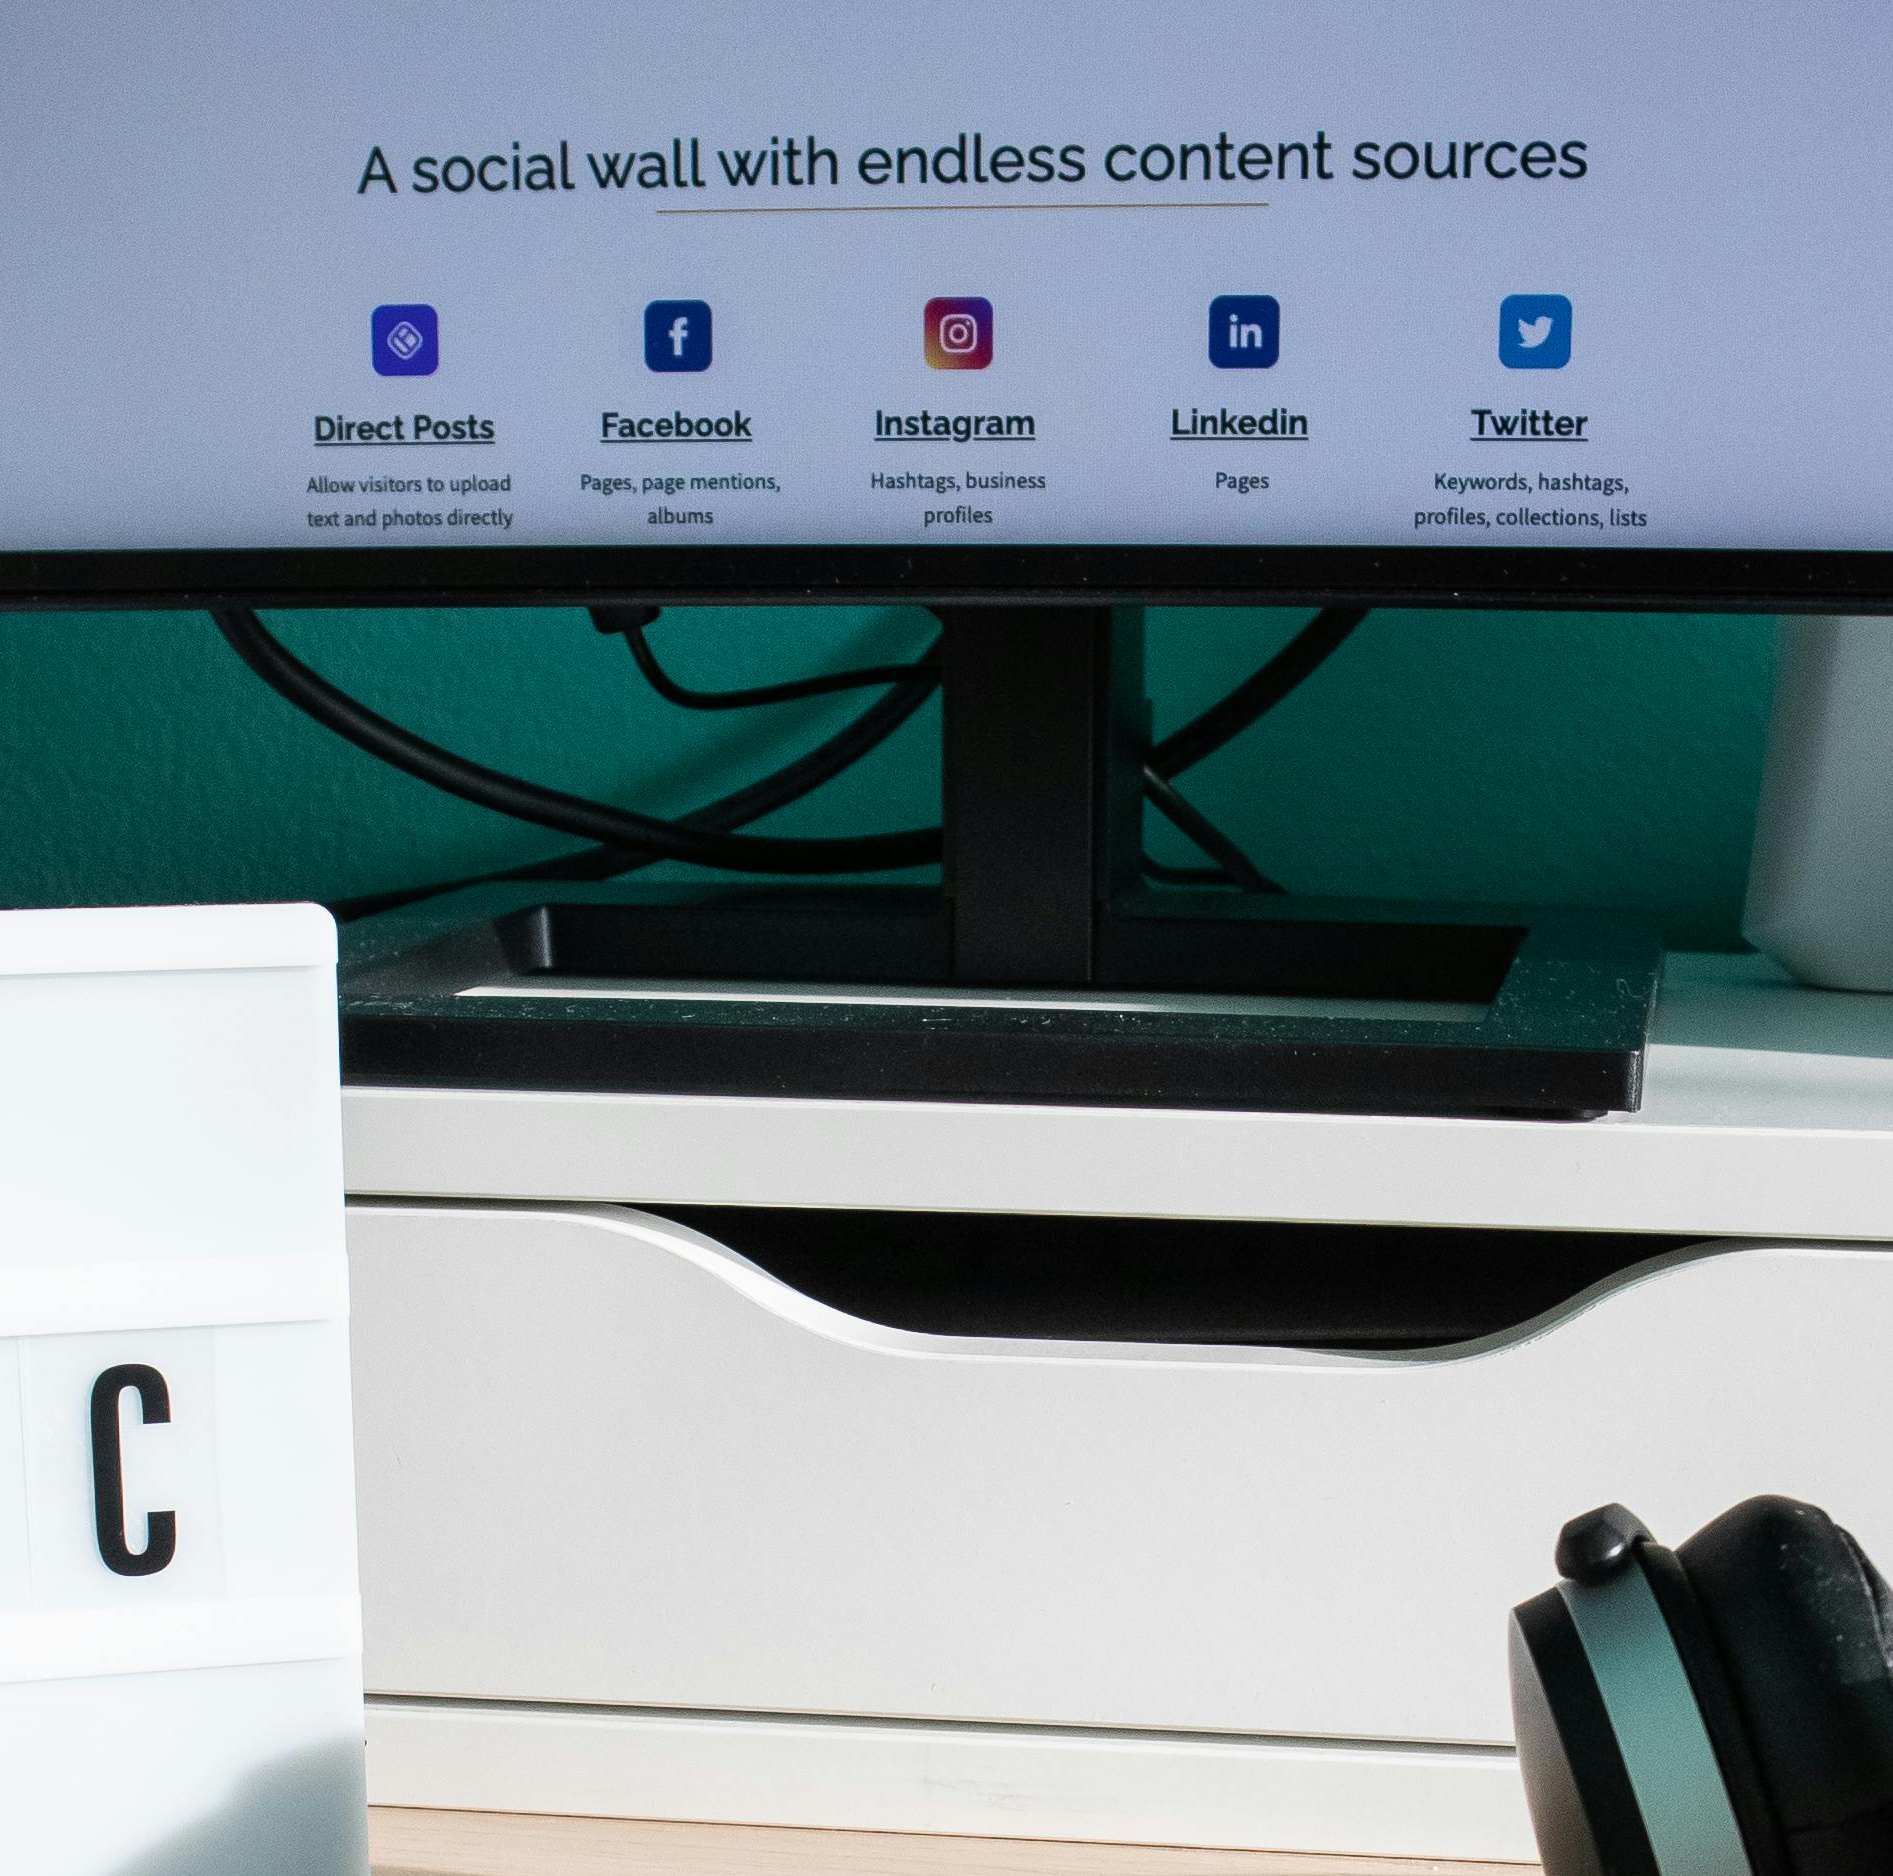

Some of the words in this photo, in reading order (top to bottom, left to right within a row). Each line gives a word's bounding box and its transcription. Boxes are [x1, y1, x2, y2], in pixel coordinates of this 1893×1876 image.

[356, 144, 399, 196] A
[411, 139, 577, 196] social
[585, 136, 708, 191] wall
[716, 134, 840, 188] with
[856, 131, 1087, 187] endless
[1103, 129, 1335, 184] content
[1351, 134, 1589, 183] sources
[314, 414, 405, 441] Direct
[413, 414, 496, 440] Posts
[602, 410, 753, 438] Facebook
[875, 409, 1036, 442] Instagram
[1172, 407, 1309, 436] Linkedin
[1470, 407, 1589, 436] Twitter
[306, 475, 355, 494] Allow
[359, 475, 423, 494] visitors
[426, 477, 445, 494] to
[449, 474, 512, 498] upload
[579, 474, 638, 498] Pages,
[642, 477, 686, 499] page
[690, 472, 782, 496] mentions,
[870, 471, 962, 496] Hashtags,
[966, 470, 1047, 491] business
[1215, 471, 1270, 495] Pages
[1434, 472, 1533, 496] Keywords,
[1538, 472, 1629, 498] hashtags,
[306, 512, 340, 529] text
[344, 509, 377, 528] and
[382, 508, 443, 531] photos
[447, 507, 514, 531] directly
[647, 506, 715, 526] albums
[923, 504, 994, 529] profiles
[1413, 506, 1491, 531] profiles,
[1495, 507, 1605, 531] collections,
[1609, 508, 1648, 528] lists
